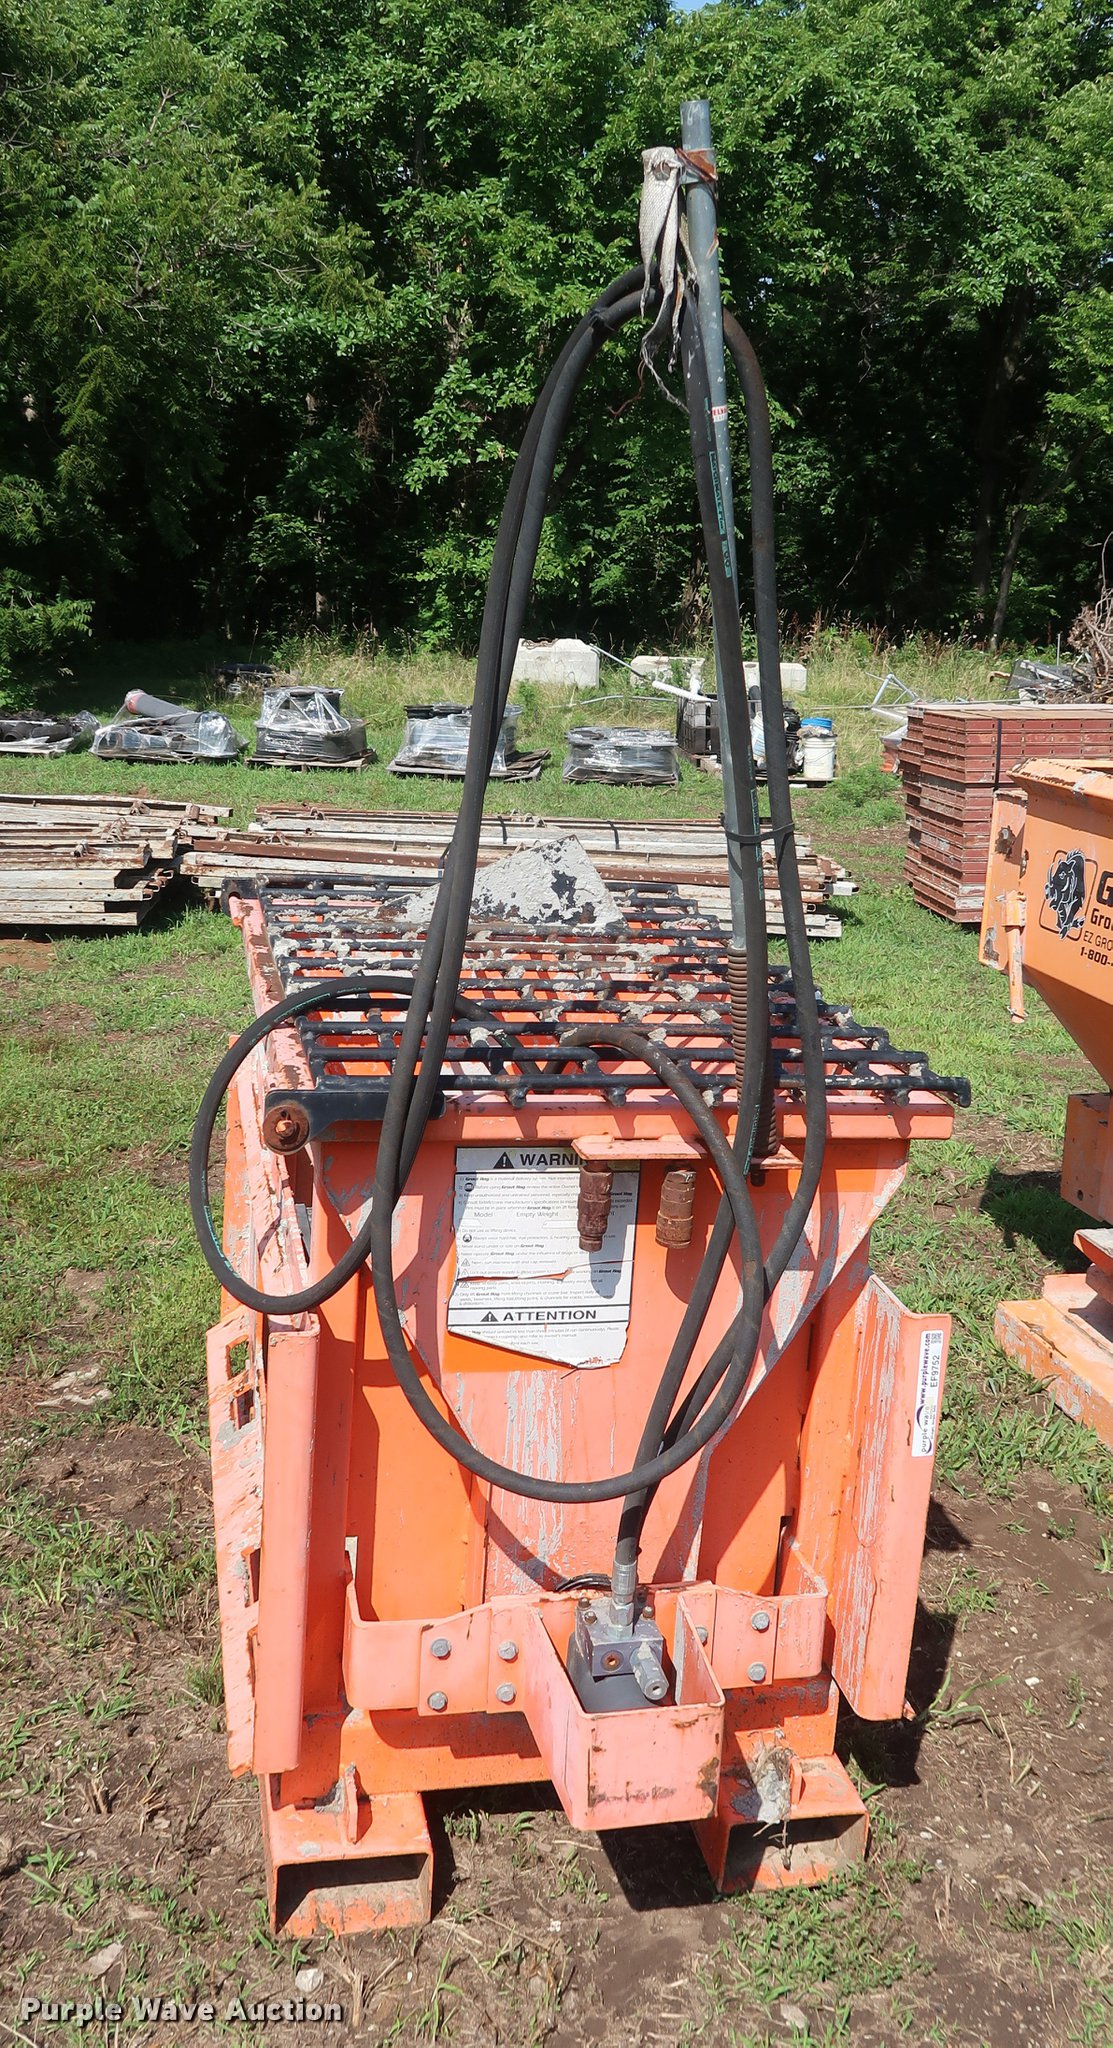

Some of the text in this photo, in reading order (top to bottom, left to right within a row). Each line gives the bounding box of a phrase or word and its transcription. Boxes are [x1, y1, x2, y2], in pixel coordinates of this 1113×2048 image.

[1091, 908, 1113, 931] Gro
[1083, 931, 1094, 944] EZ
[1080, 946, 1113, 967] 1-800-
[516, 1211, 560, 1219] Empty Weight
[503, 1310, 596, 1321] ATTENTION
[920, 1333, 931, 1404] www.purplewave.com
[930, 1355, 940, 1388] EF9752
[921, 1428, 929, 1453] purple
